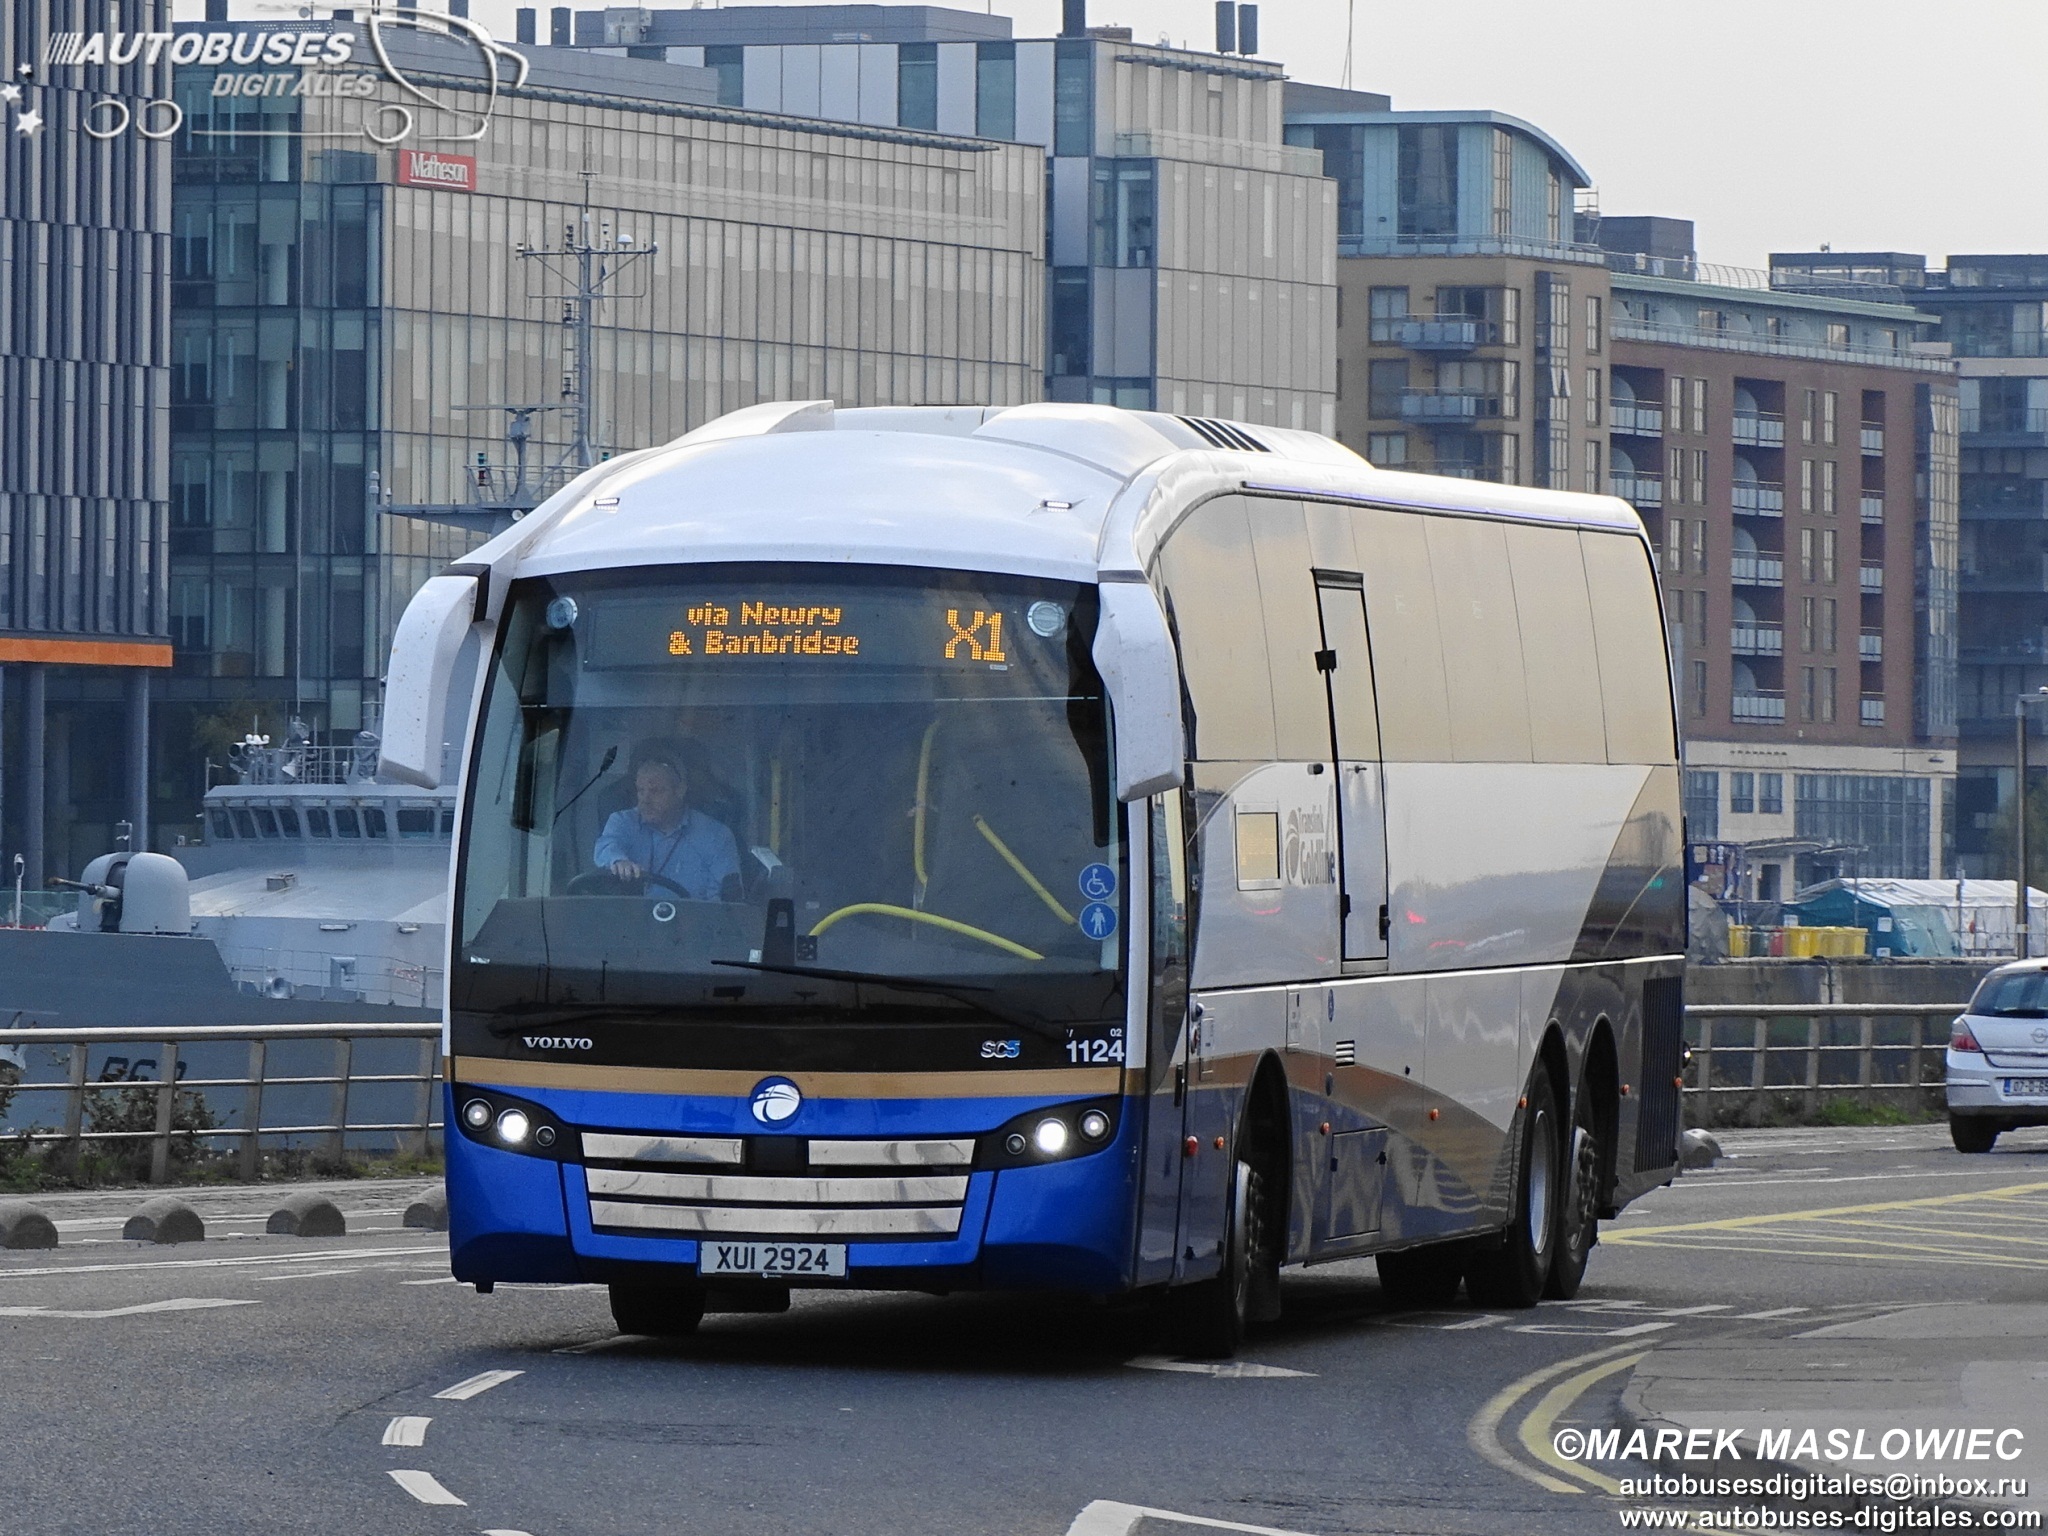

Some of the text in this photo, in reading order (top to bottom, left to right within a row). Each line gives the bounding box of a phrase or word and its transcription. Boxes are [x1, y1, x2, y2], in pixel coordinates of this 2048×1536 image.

[409, 152, 469, 182] Matheson
[687, 601, 841, 627] via Newry
[668, 629, 860, 656] & Banbridge
[944, 608, 1006, 662] X1
[522, 1036, 593, 1050] VOLVO
[980, 1039, 1021, 1059] SC5
[1066, 1039, 1125, 1063] 1124
[716, 1246, 829, 1271] XUI 2924
